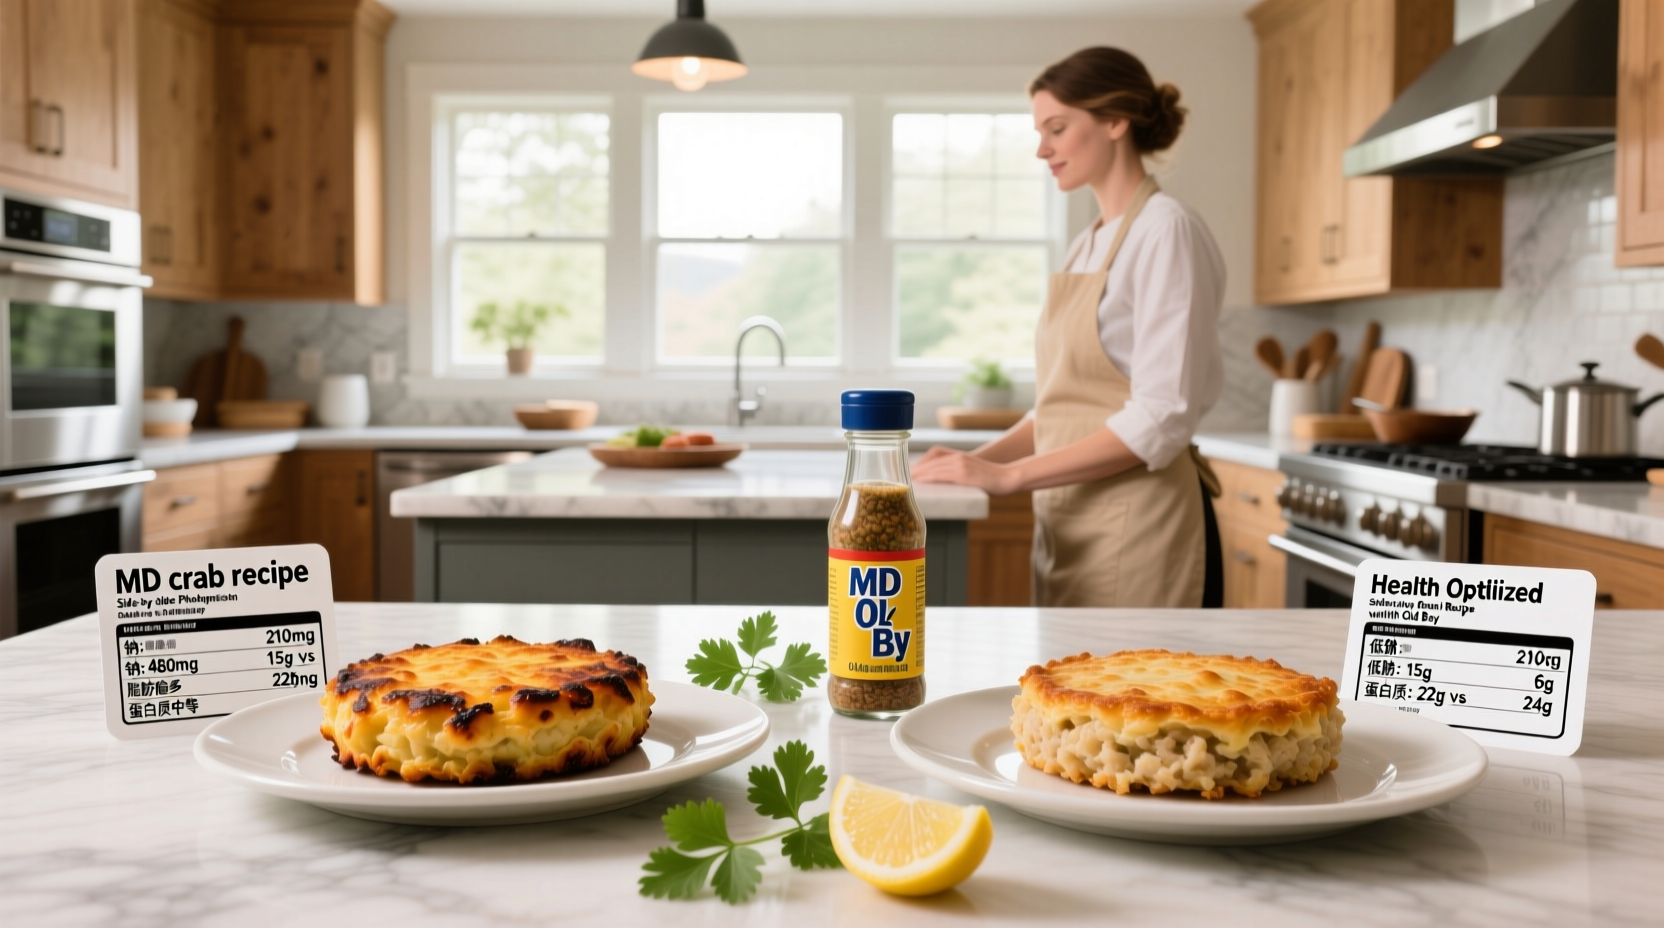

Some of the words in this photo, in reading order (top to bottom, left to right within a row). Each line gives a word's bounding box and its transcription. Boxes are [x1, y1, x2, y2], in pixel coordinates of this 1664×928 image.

[116, 568, 161, 594] MD
[169, 563, 225, 590] crab
[232, 560, 309, 590] recipe
[849, 567, 902, 597] MD
[1370, 574, 1440, 598] Health
[266, 628, 315, 646] 210mg
[872, 628, 911, 662] By
[148, 658, 198, 674] 480mg
[266, 650, 294, 668] 15g
[298, 652, 316, 664] vs
[1408, 662, 1432, 683] 15g
[1534, 674, 1554, 694] 6g
[1416, 686, 1446, 706] 22g
[1450, 692, 1467, 704] vs
[1522, 696, 1552, 717] 24g
